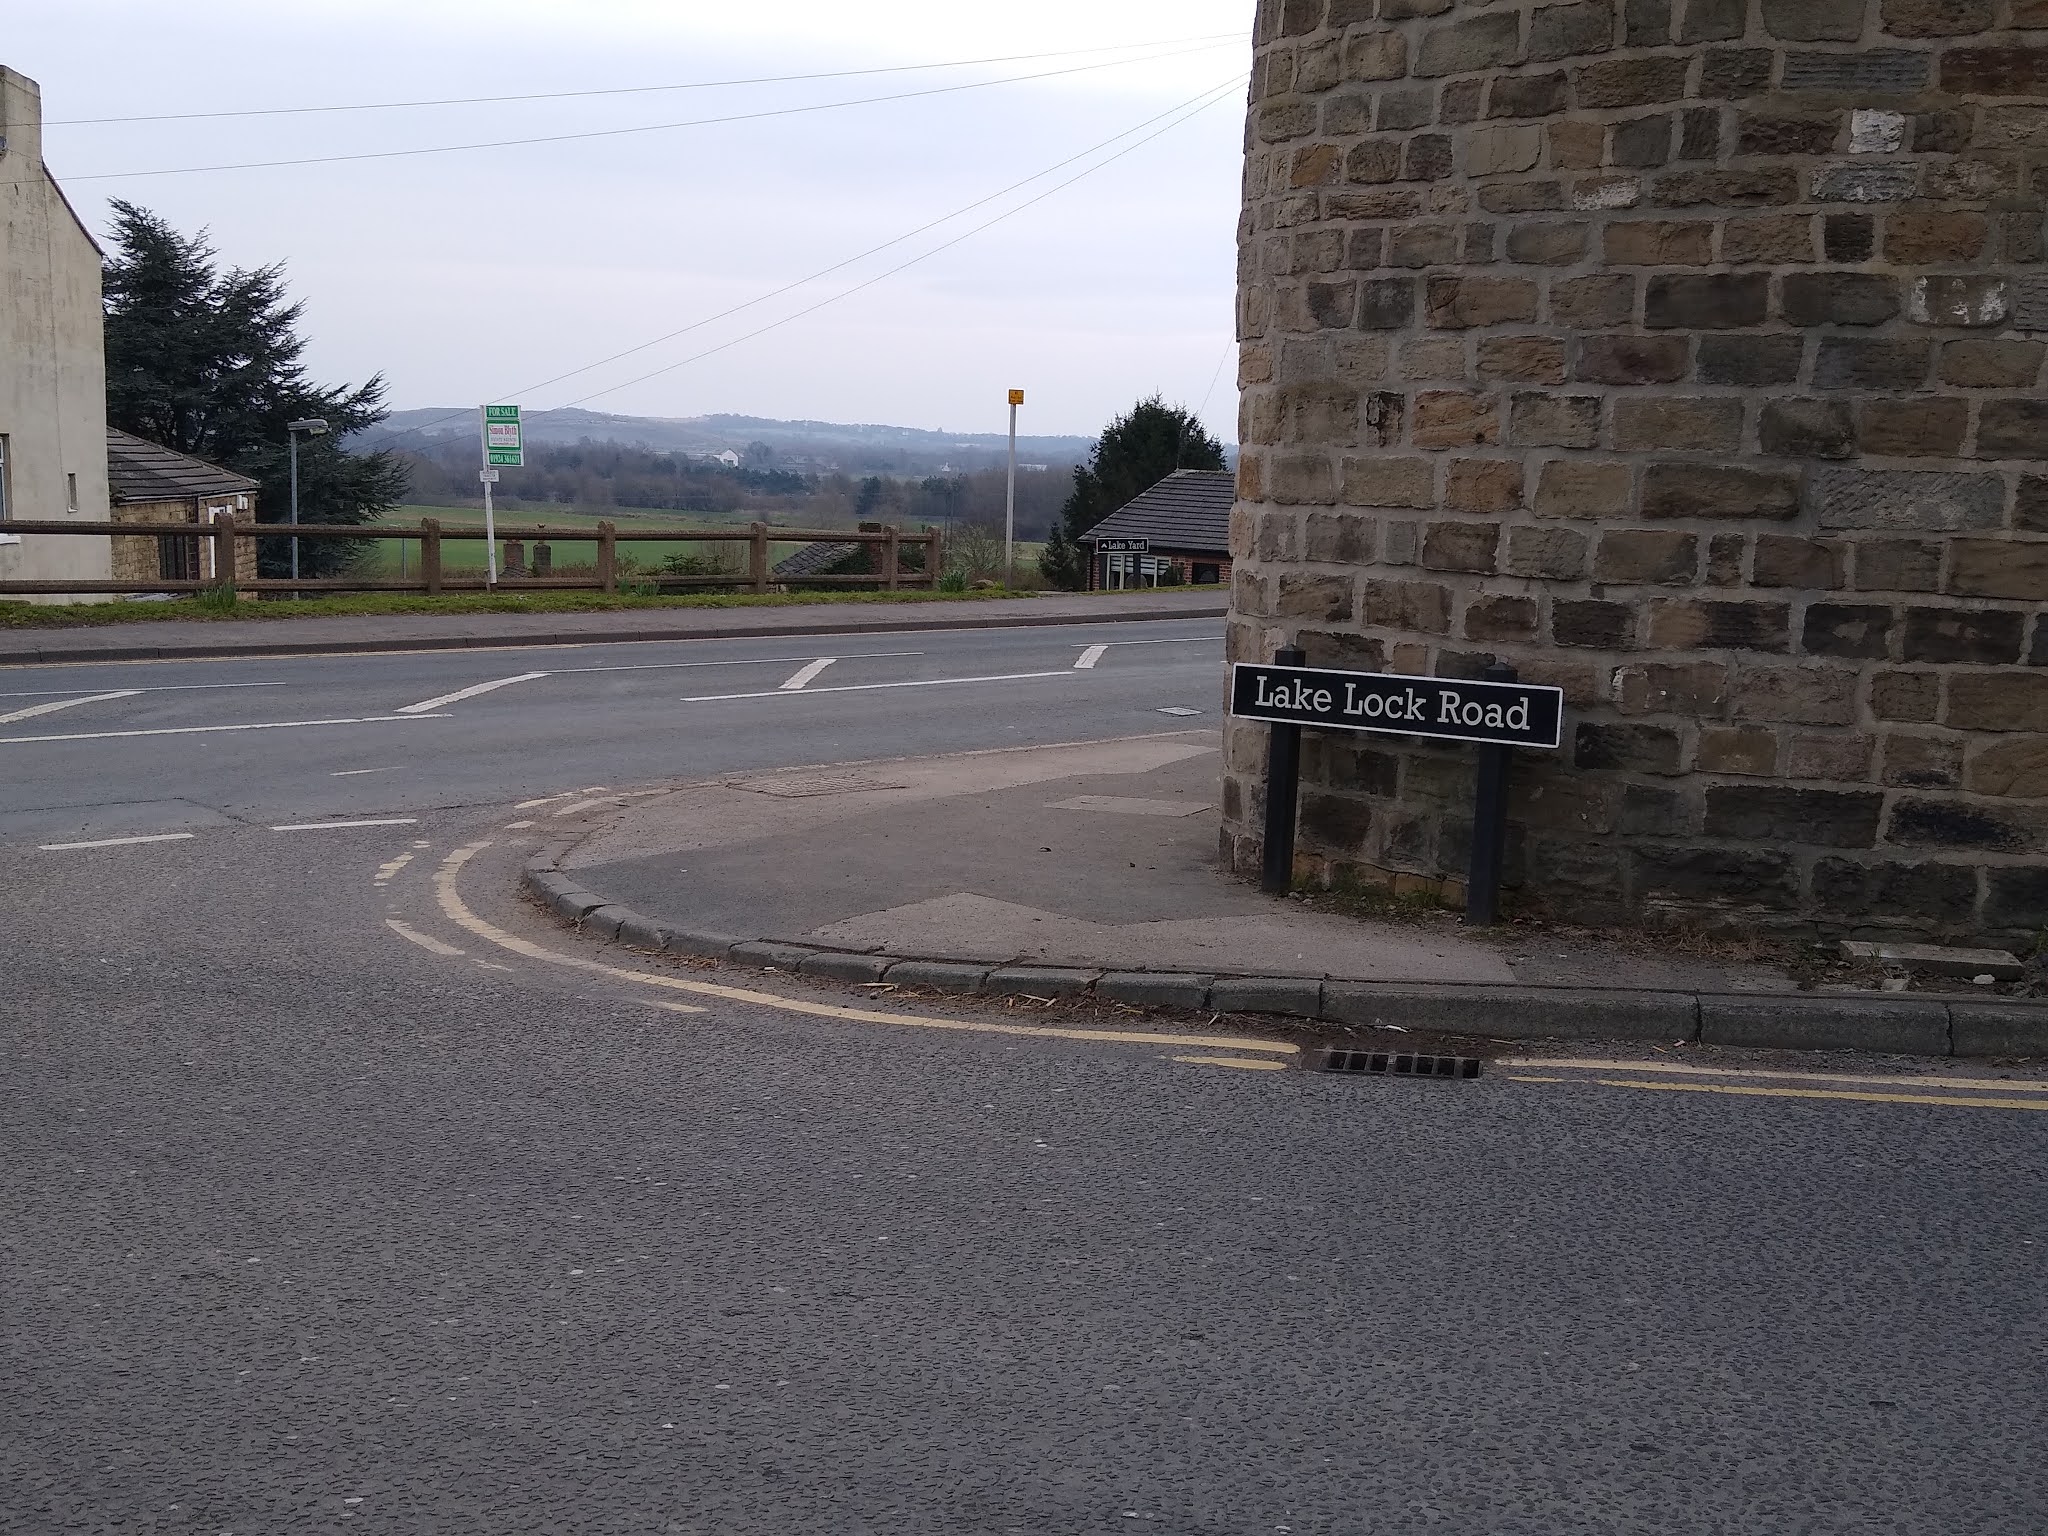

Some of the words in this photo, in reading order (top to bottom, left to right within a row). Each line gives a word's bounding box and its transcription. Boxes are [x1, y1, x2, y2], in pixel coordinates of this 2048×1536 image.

[488, 407, 500, 417] FOR
[501, 407, 517, 417] SALE
[1108, 541, 1126, 550] Lake
[1128, 541, 1145, 550] Yard
[1254, 675, 1332, 713] Lake
[1343, 682, 1427, 721] Lock
[1436, 690, 1531, 731] Road
